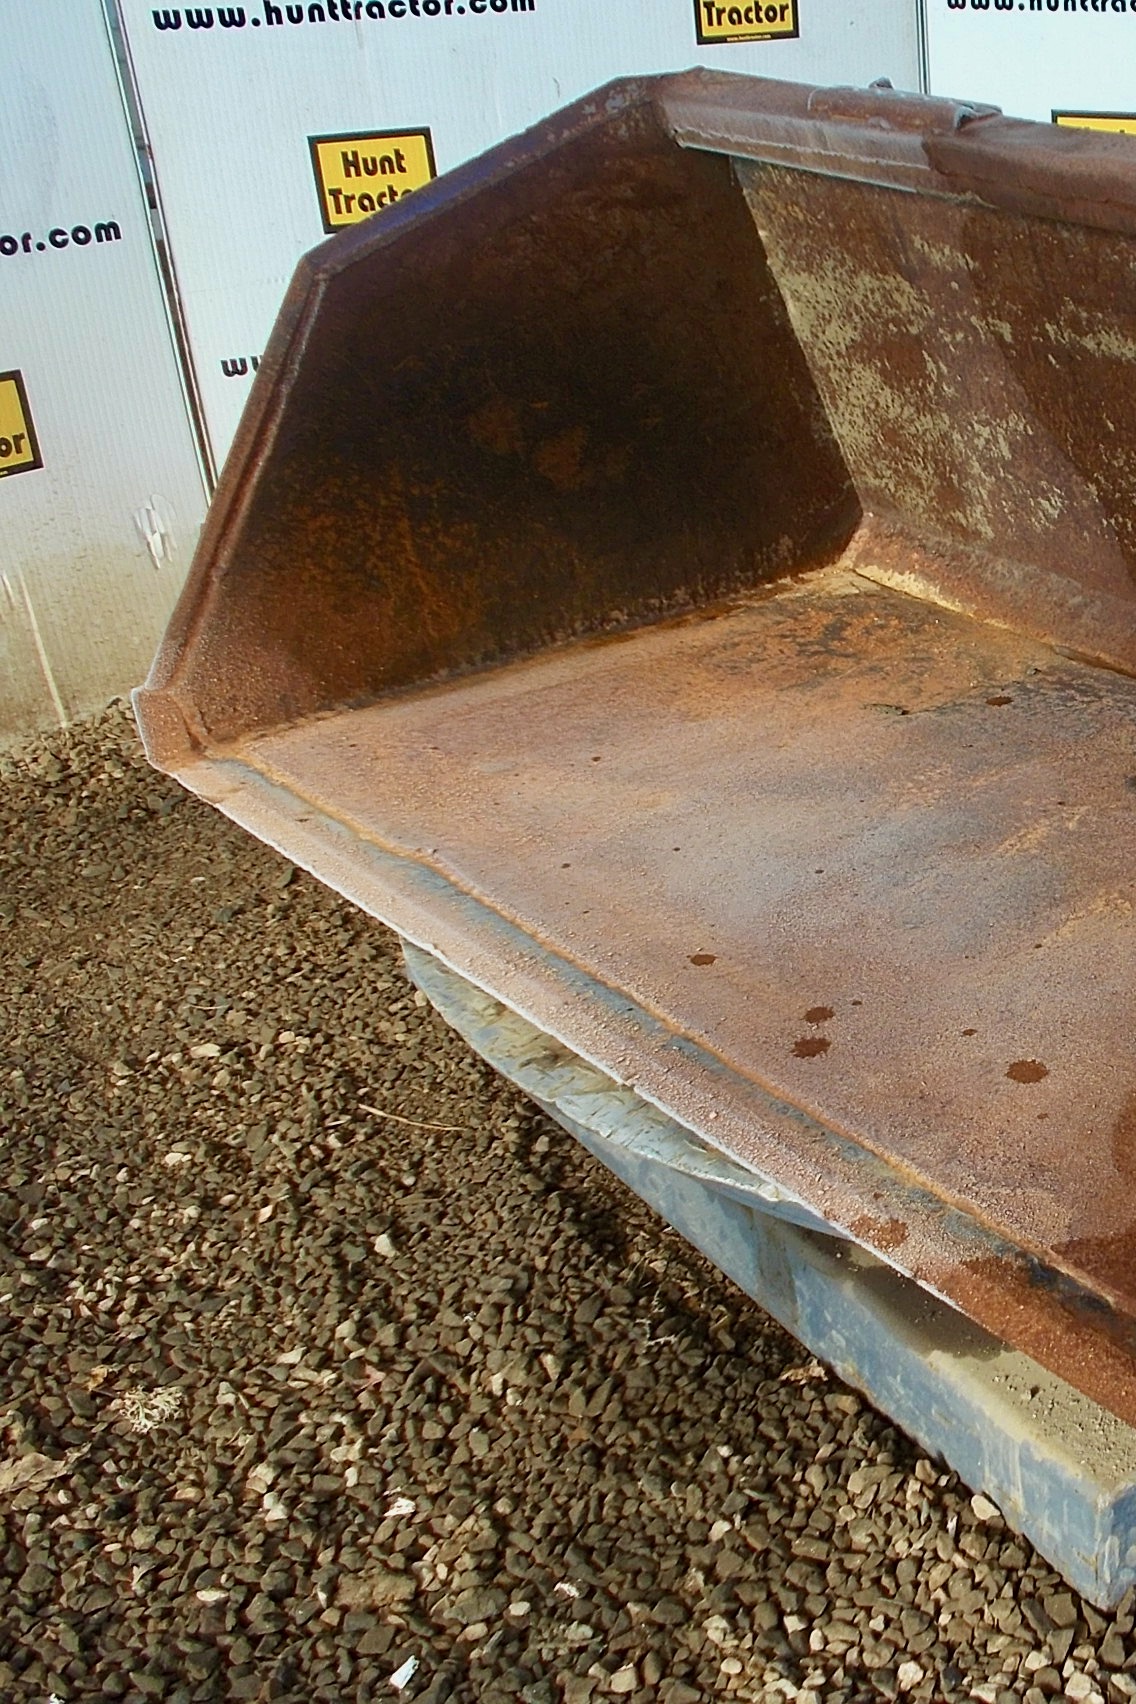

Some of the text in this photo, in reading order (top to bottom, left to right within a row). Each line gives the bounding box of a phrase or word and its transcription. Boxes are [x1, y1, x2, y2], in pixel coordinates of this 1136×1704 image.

[703, 0, 789, 27] Tractor
[341, 148, 407, 178] Hunt
[328, 184, 413, 214] Tract
